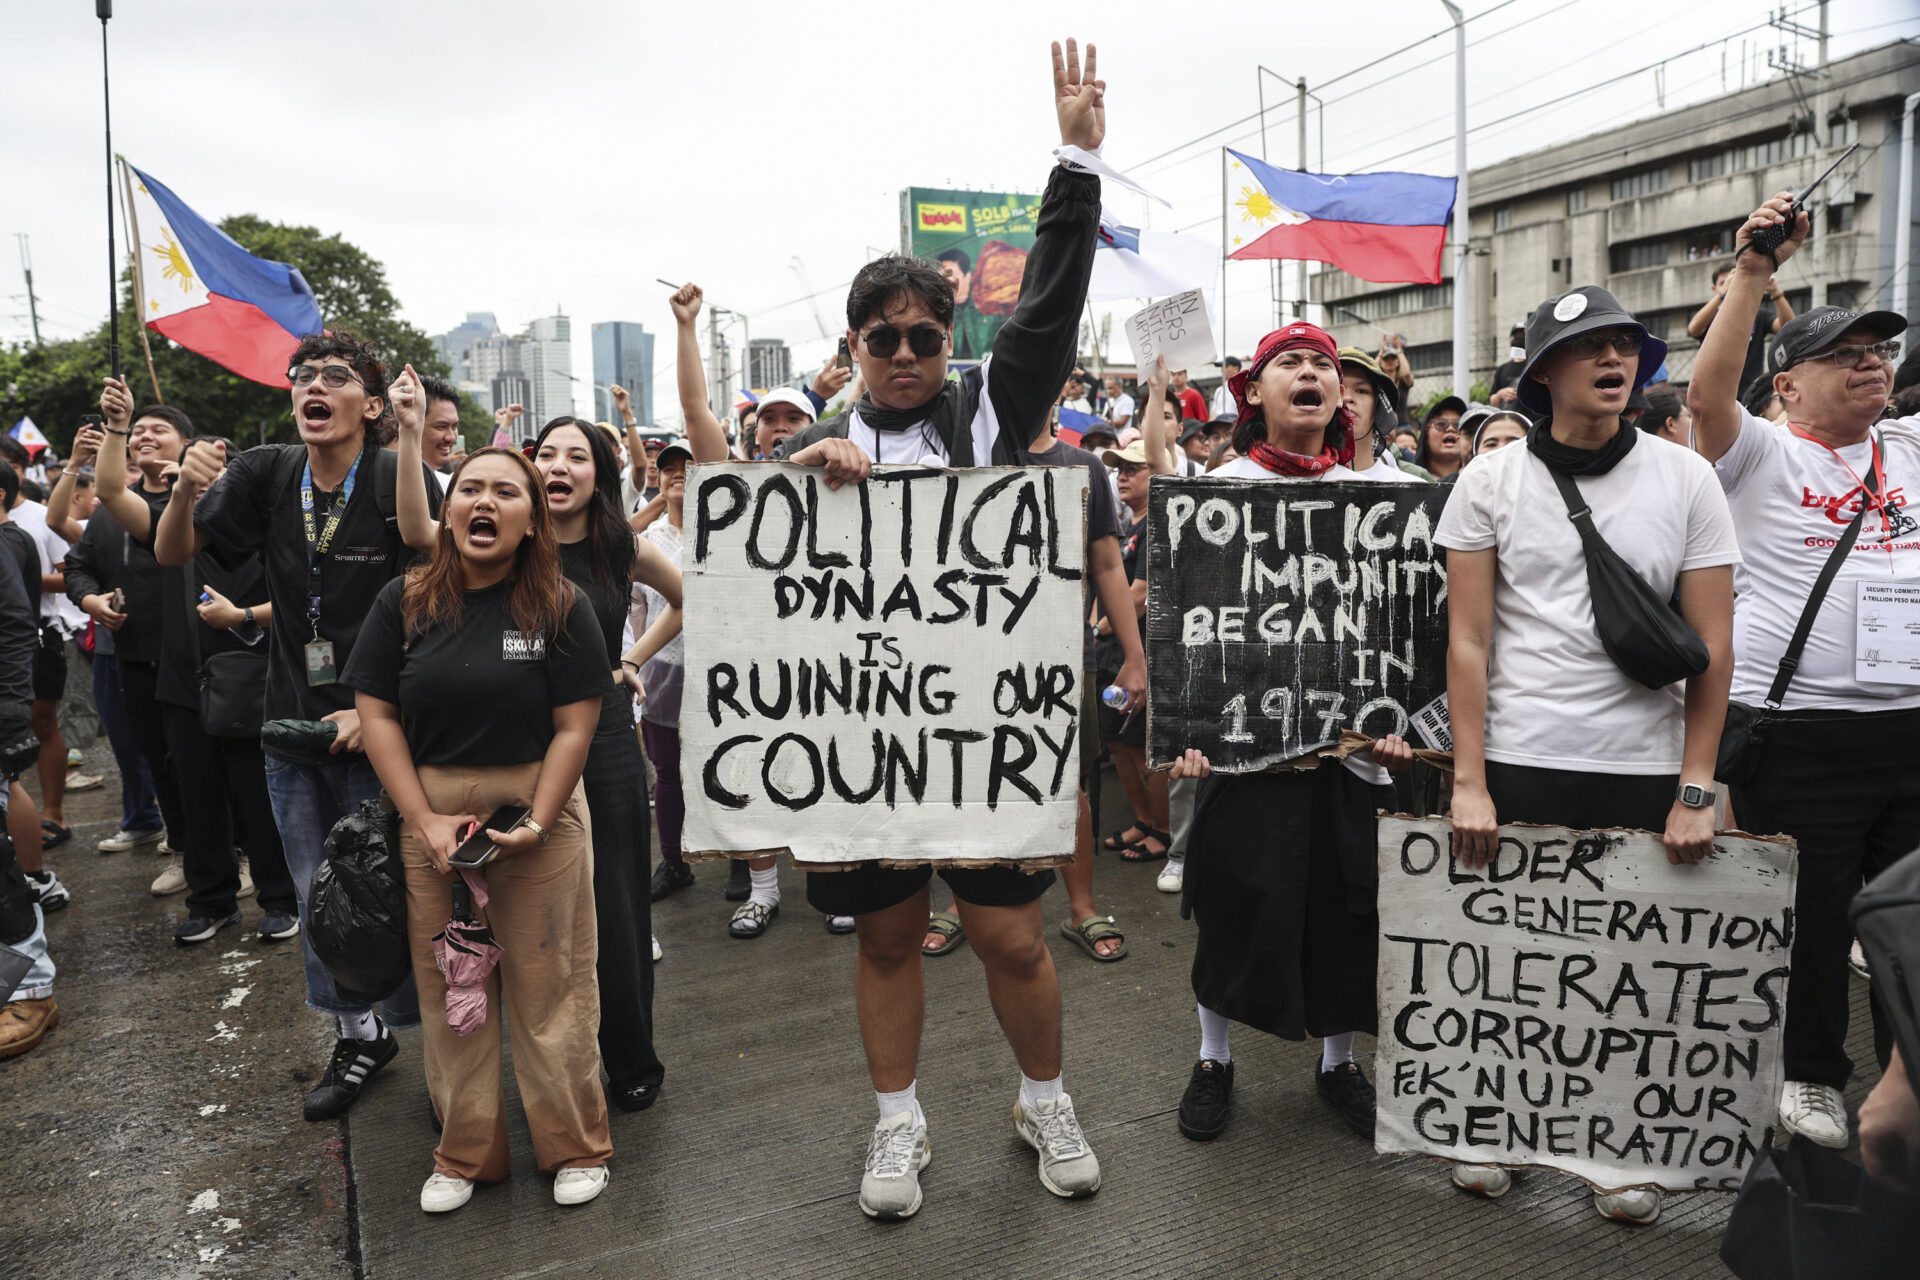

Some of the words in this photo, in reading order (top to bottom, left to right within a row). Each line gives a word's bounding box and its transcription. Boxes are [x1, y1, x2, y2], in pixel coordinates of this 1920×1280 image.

[970, 205, 1011, 222] SOLB
[1134, 309, 1154, 367] UPTION
[1148, 305, 1164, 343] NTI-
[304, 513, 316, 542] RTU
[319, 516, 341, 554] ISKOLAR
[692, 468, 1083, 580] POLITICAL
[1165, 494, 1434, 560] POLITICA
[774, 569, 1041, 635] DYNASTY
[1866, 586, 1893, 594] SECURITY
[857, 632, 903, 670] IS
[1182, 601, 1368, 648] BEGAN
[707, 653, 960, 727] RUINING
[993, 661, 1078, 720] OUR
[1350, 640, 1415, 688] IN
[1219, 686, 1409, 744] 1970
[1421, 710, 1438, 729] OUR
[702, 718, 1078, 812] COUNTRY
[1400, 830, 1609, 892] OLDER
[1461, 887, 1796, 953] GENERATION
[1384, 933, 1790, 1033] TOLERATES
[1393, 1000, 1760, 1082] CORRUPTION
[1518, 1069, 1594, 1108] UP
[1633, 1082, 1752, 1127] OUR
[1413, 1095, 1775, 1171] GENERATION
